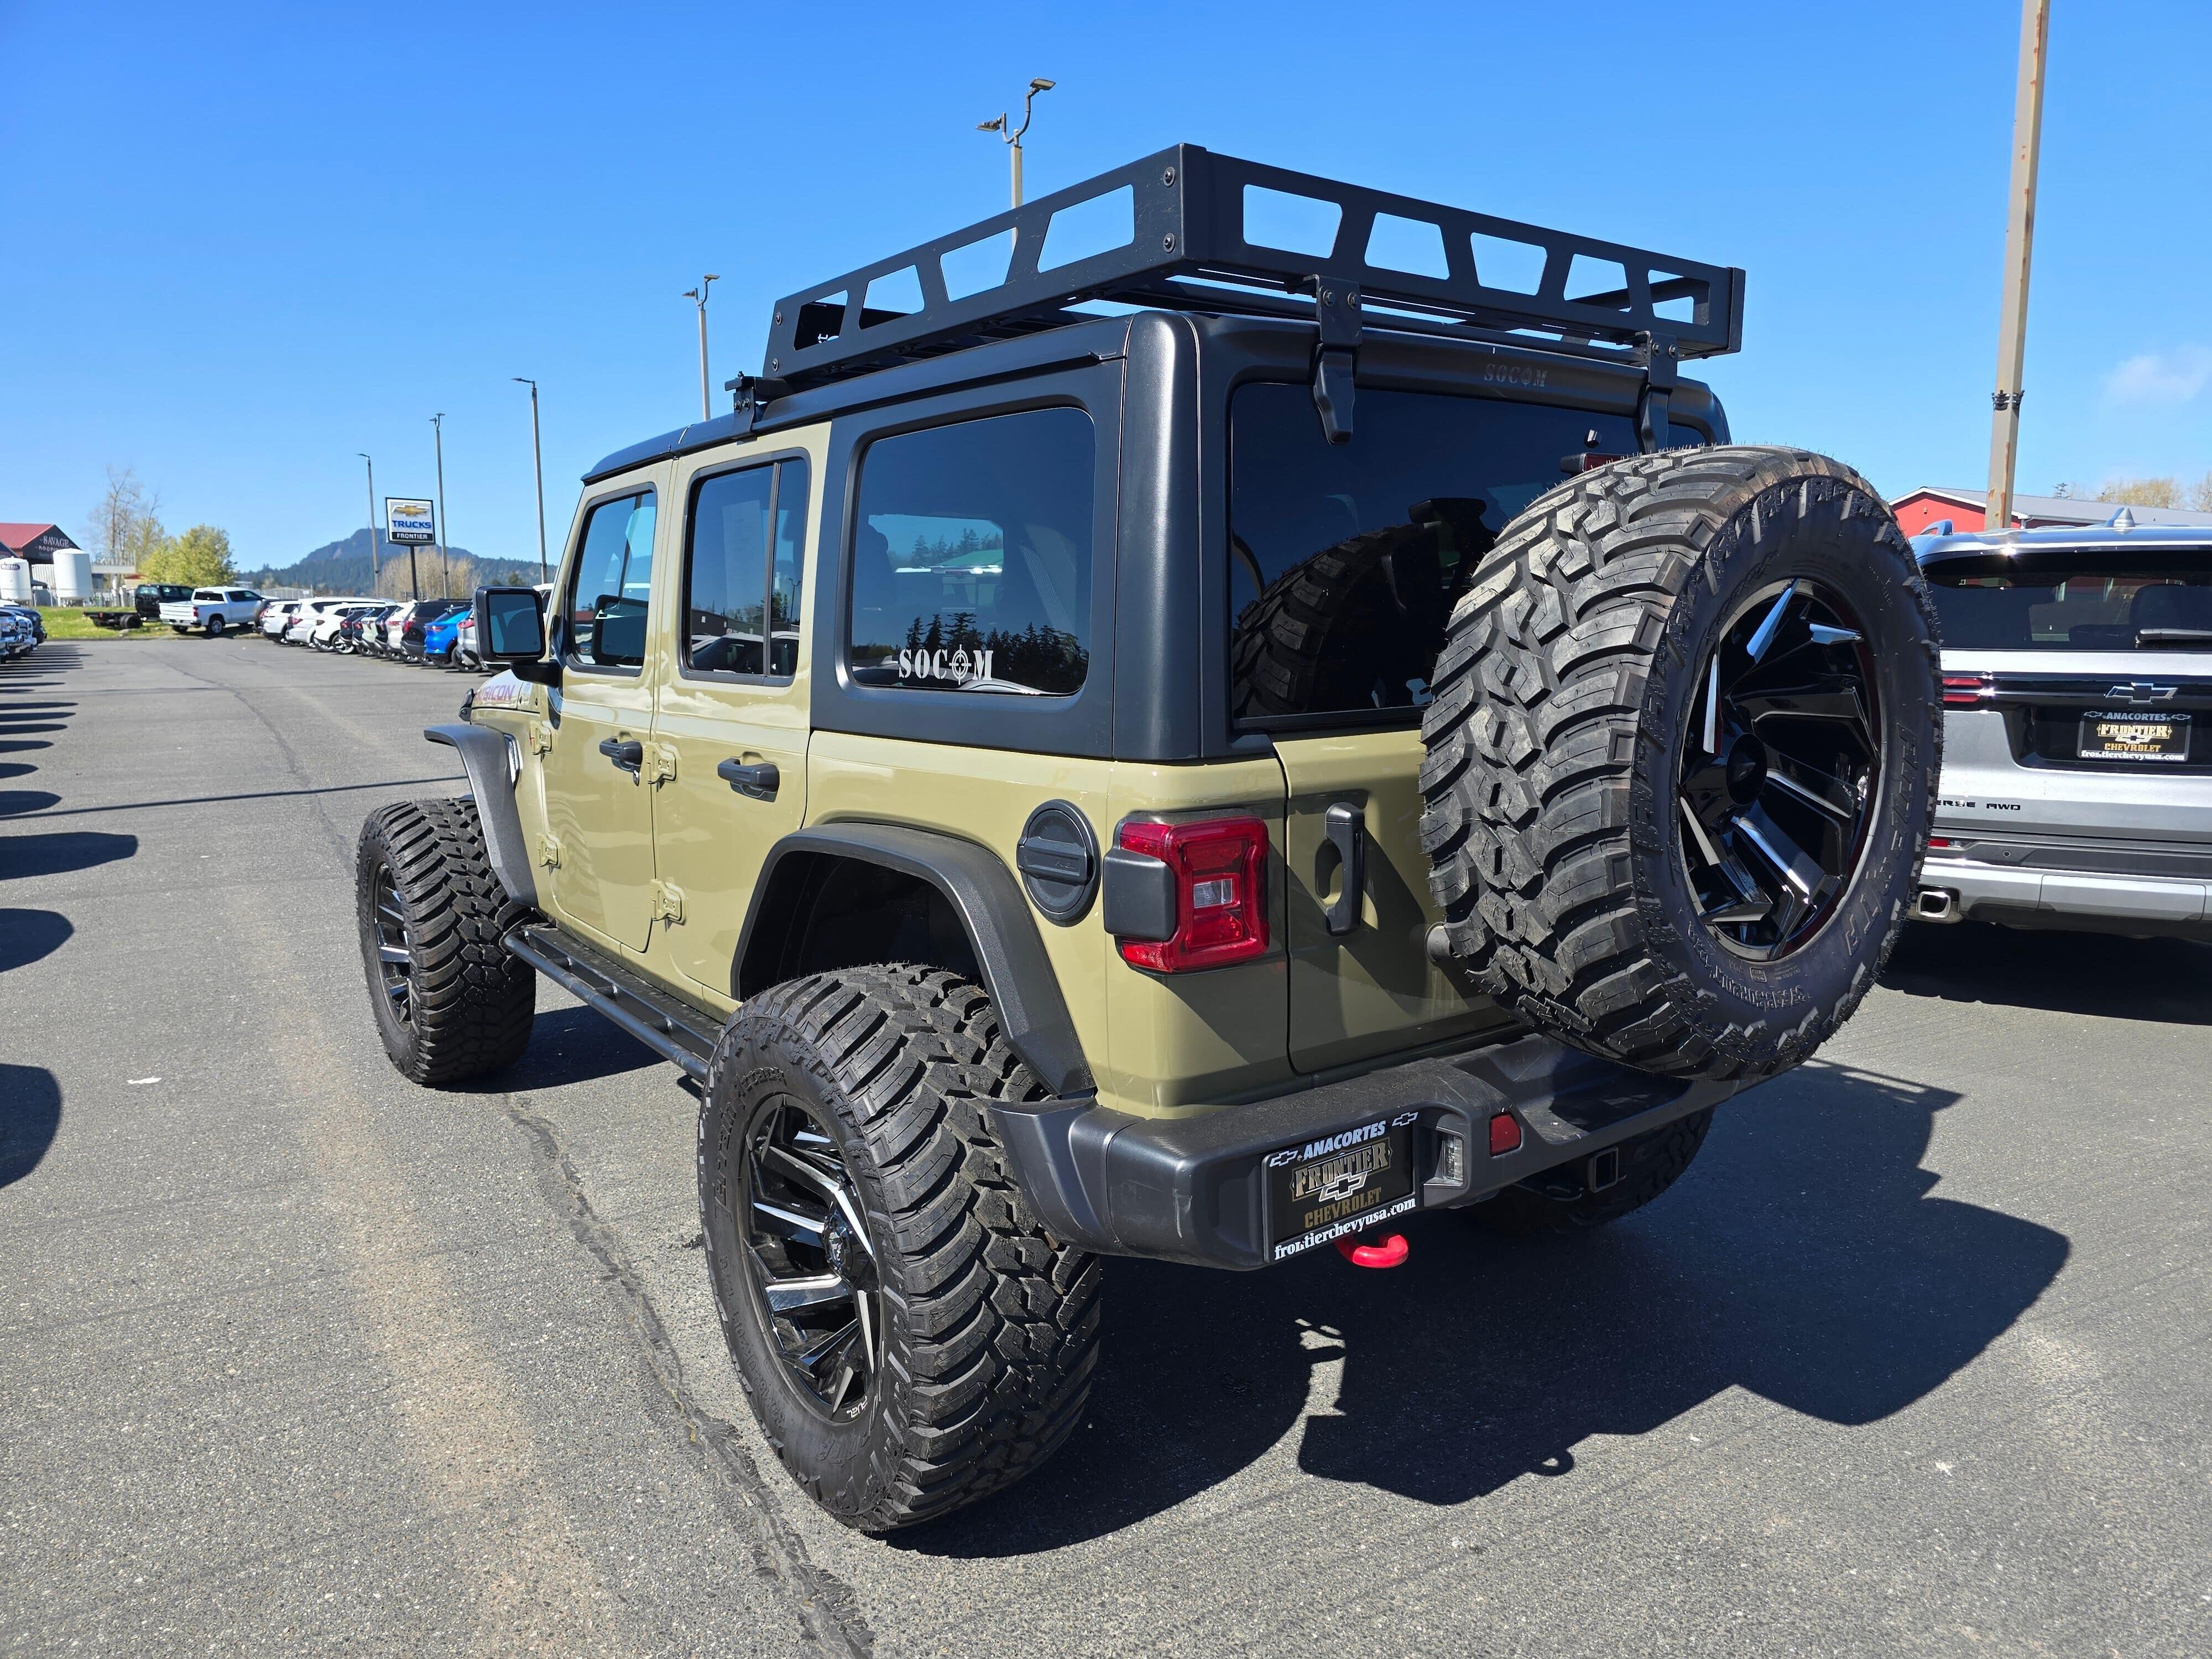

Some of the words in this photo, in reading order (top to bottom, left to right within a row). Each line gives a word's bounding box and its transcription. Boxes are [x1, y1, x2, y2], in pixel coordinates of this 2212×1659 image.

[392, 520, 431, 528] TRUCKS
[43, 535, 69, 547] SAVAGE
[2106, 712, 2167, 721] ANACORTES
[2100, 724, 2168, 737] FRONTIER
[2104, 743, 2161, 753] CHEVROLET
[2081, 750, 2184, 761] frontierchevyusa.com
[1303, 1120, 1386, 1160] ANACORTES
[1295, 1142, 1389, 1197] FRONTIER
[1304, 1187, 1381, 1228] CHEVROLET
[1275, 1198, 1416, 1260] frontierchevyusa.com
[847, 1395, 868, 1418] FUEL
